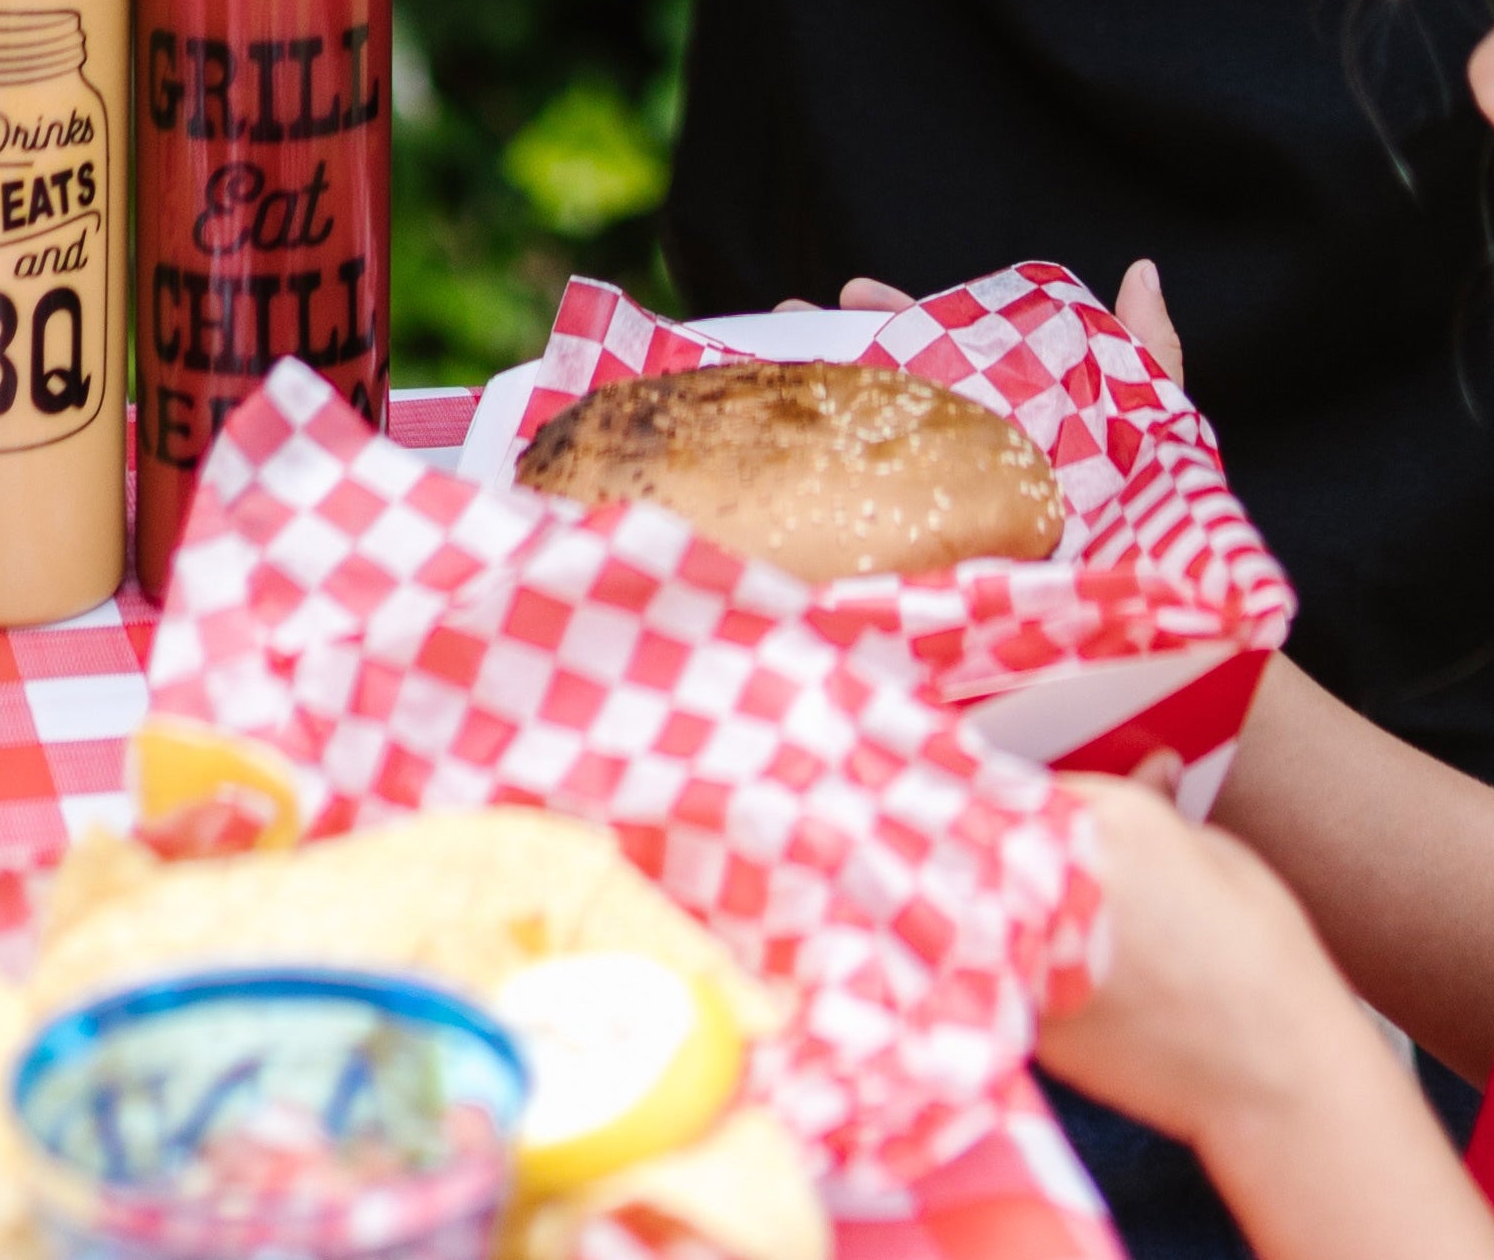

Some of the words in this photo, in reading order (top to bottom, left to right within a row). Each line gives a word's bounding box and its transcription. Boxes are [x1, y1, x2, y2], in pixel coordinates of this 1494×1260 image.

[148, 23, 380, 145] GRILL
[1, 161, 96, 232] EATS
[193, 159, 334, 258] Eat
[13, 229, 89, 279] and
[152, 257, 376, 376] CHILL
